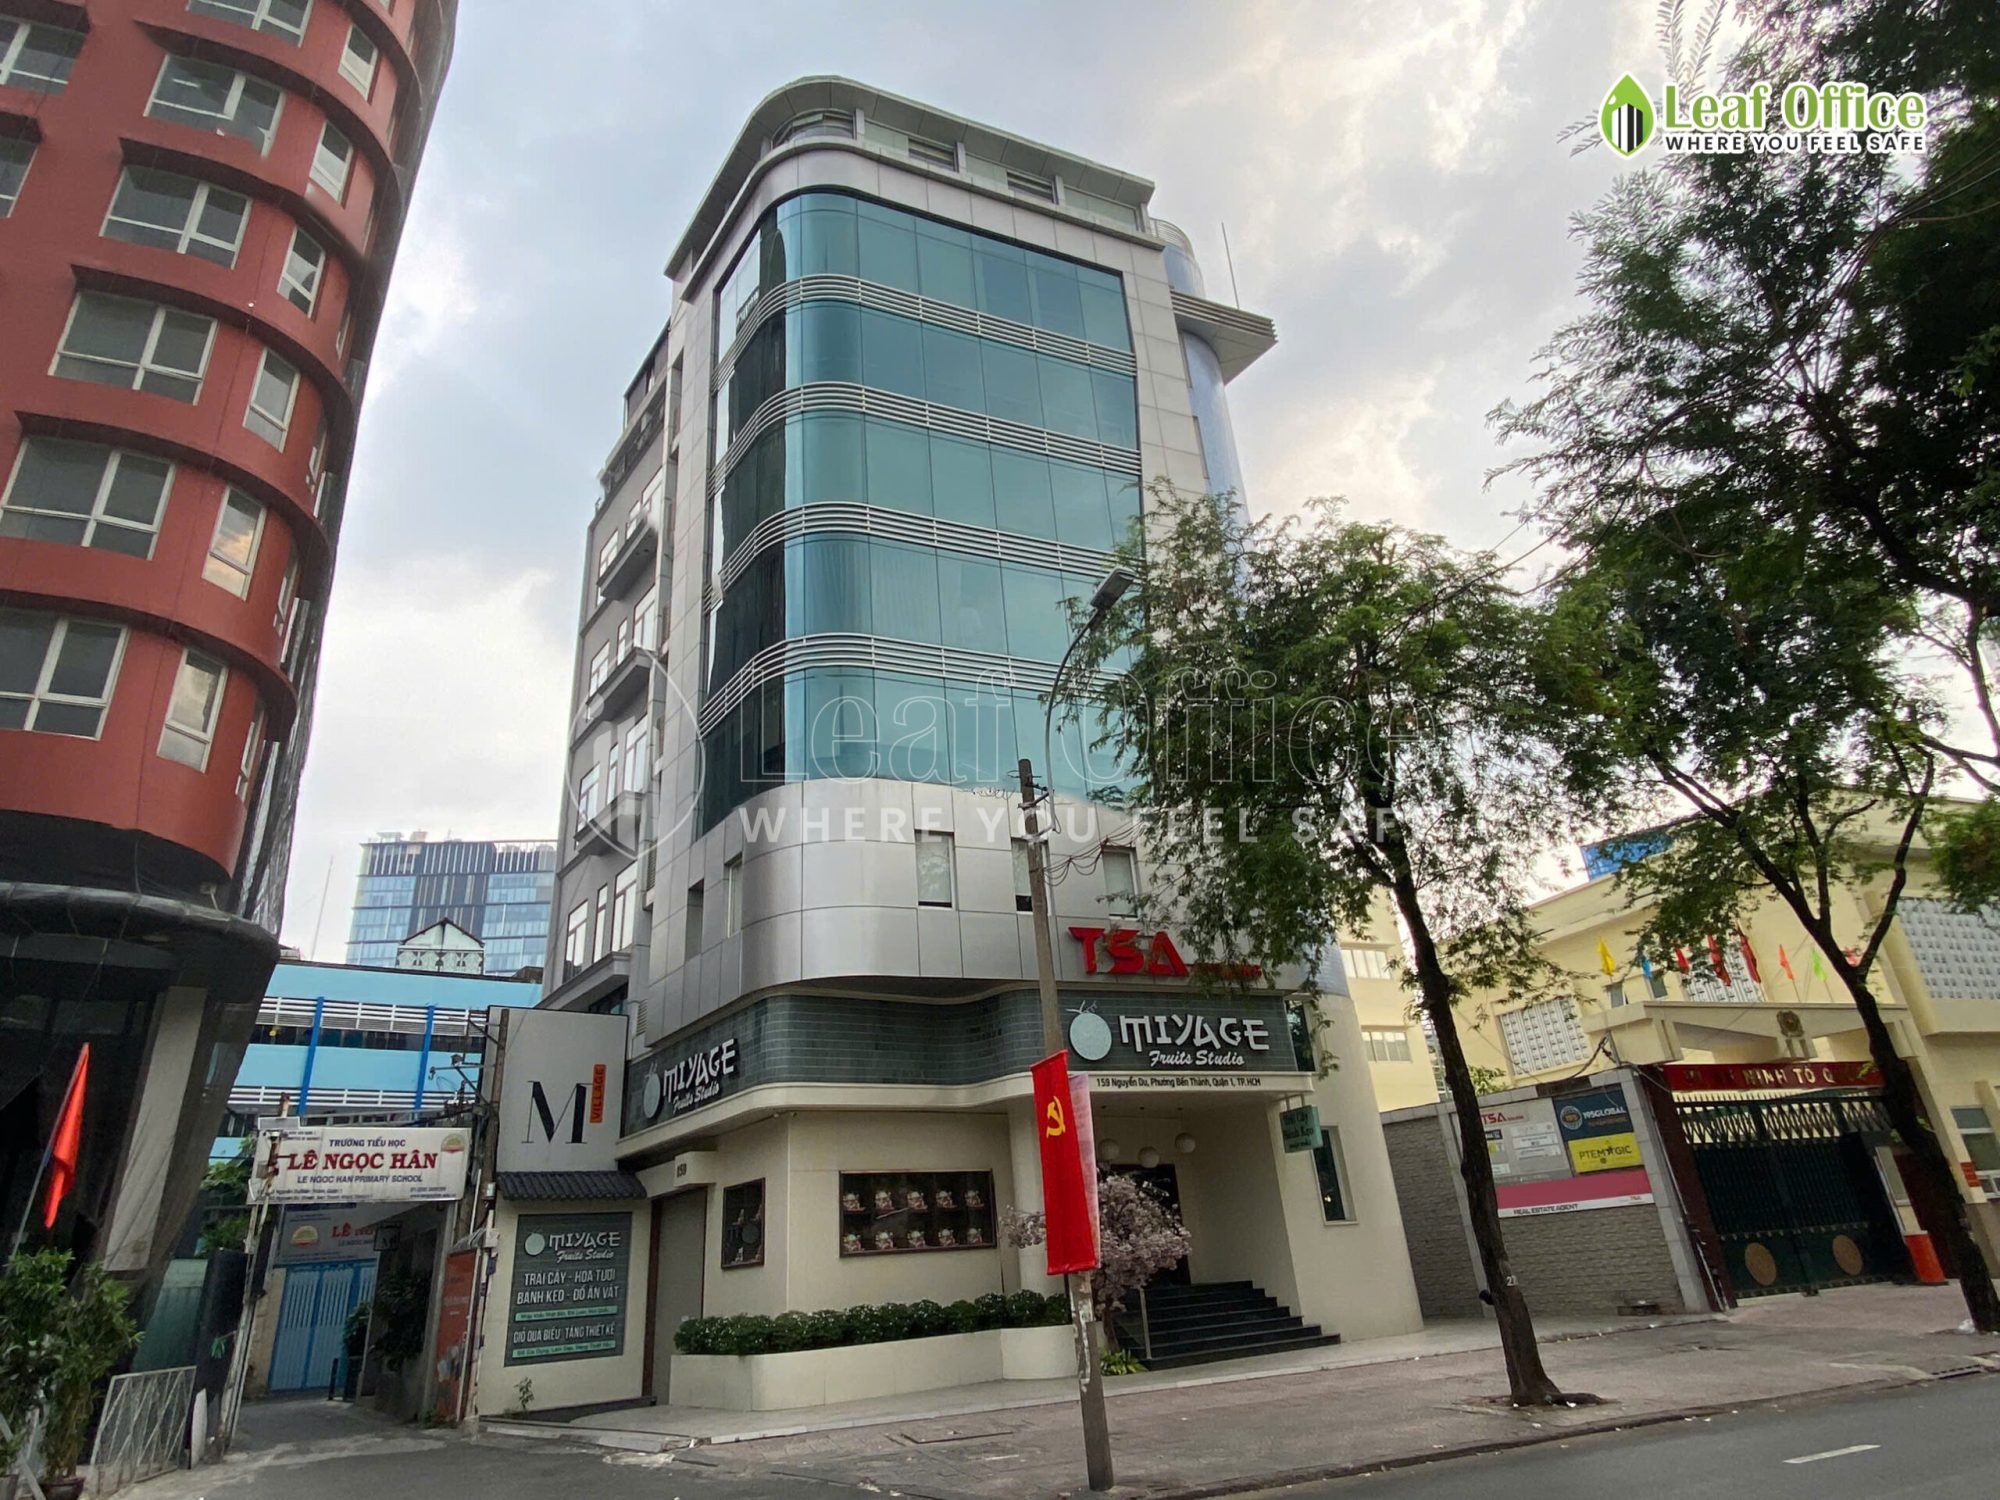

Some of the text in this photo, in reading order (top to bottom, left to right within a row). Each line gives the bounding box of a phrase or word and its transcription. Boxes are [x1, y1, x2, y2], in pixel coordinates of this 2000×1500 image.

[1068, 927, 1190, 977] TSA
[1119, 1014, 1270, 1052] MIYAGE
[1149, 1050, 1245, 1067] Fruits Studio
[663, 1038, 736, 1103] MIYAGE
[1097, 1077, 1110, 1087] 159
[673, 1083, 720, 1114] Fruits Studio
[288, 1150, 438, 1173] LÊ NGỌC HÂN
[310, 1175, 334, 1183] NGOC
[354, 1175, 390, 1183] PRIMARY
[392, 1174, 422, 1182] SCHOOL
[549, 1231, 621, 1250] MIYAGE
[557, 1248, 614, 1263] Fruits Studio
